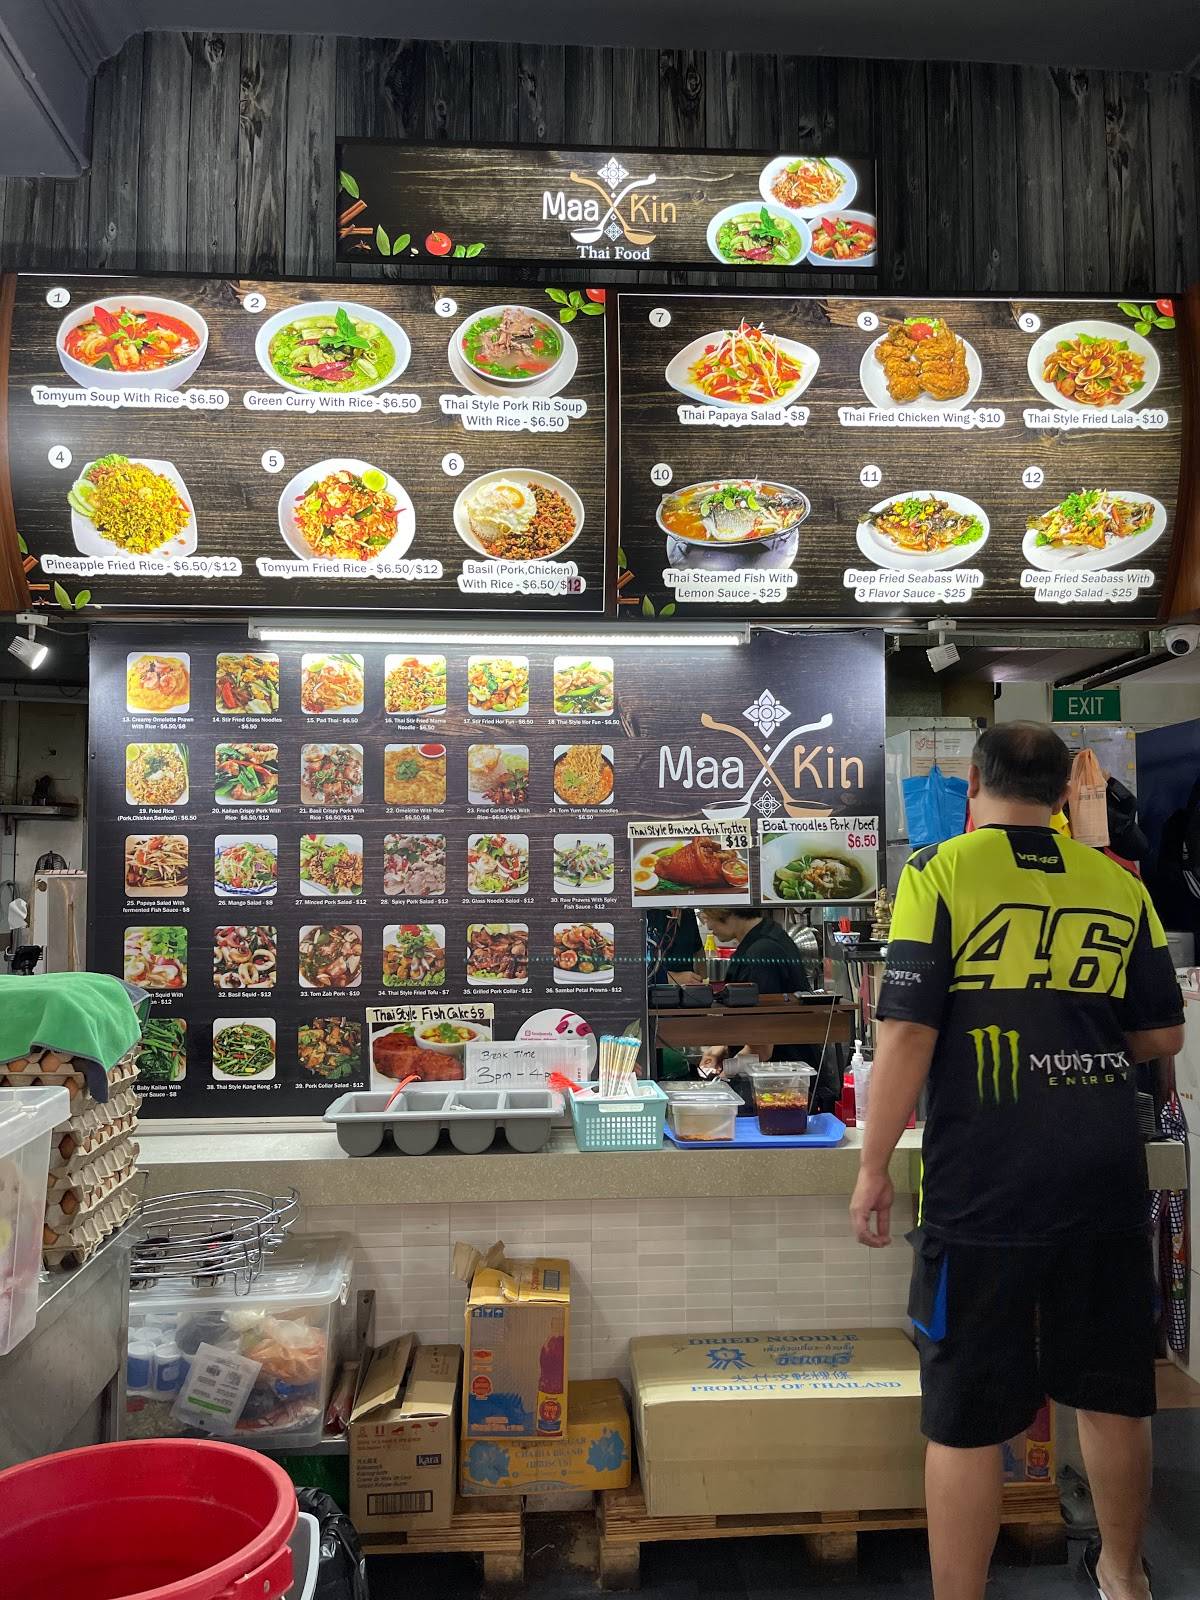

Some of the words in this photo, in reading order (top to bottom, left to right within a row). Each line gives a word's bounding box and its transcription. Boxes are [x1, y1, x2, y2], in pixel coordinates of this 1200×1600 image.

[542, 191, 599, 221] Maa
[631, 193, 676, 223] Kin
[576, 245, 610, 259] Thai
[614, 247, 650, 260] Food
[54, 293, 62, 302] 1
[251, 298, 259, 308] 2
[442, 302, 450, 312] 3
[656, 313, 664, 322] 7
[864, 317, 872, 326] 8
[1026, 318, 1034, 327] 9
[36, 390, 86, 403] Tomyum
[90, 391, 119, 403] Soup
[123, 392, 149, 402] With
[154, 393, 179, 403] Rice
[189, 394, 223, 404] $6.50
[248, 395, 282, 405] Green
[286, 396, 315, 408] Curry
[319, 397, 344, 406] With
[349, 397, 372, 407] Rice
[383, 398, 416, 408] $6.50
[444, 399, 468, 409] Thai
[471, 399, 499, 412] Style
[503, 400, 528, 410] Pork
[532, 401, 550, 410] Rib
[553, 401, 582, 413] Soup
[466, 415, 492, 425] With
[496, 416, 520, 426] Rice
[530, 416, 564, 427] $6.50
[681, 409, 704, 419] Thai
[708, 410, 747, 422] Papaya
[750, 410, 780, 420] Salad
[790, 411, 804, 420] $8
[842, 412, 864, 421] Thai
[869, 412, 894, 421] Fried
[897, 412, 939, 422] Chicken
[943, 413, 970, 424] Wing
[979, 412, 1000, 423] $10
[1027, 413, 1049, 423] Thai
[1053, 413, 1079, 425] Style
[1082, 414, 1107, 423] Fried
[1111, 414, 1133, 423] Lala
[1142, 414, 1163, 424] $10
[56, 452, 64, 462] 4
[269, 456, 277, 466] 5
[449, 458, 457, 470] 6
[654, 470, 669, 480] 10
[864, 471, 878, 482] 11
[1026, 472, 1040, 482] 12
[46, 559, 103, 571] Pineapple
[107, 560, 135, 570] Fried
[139, 560, 163, 570] Rice
[173, 560, 236, 572] $6.50/$12
[261, 562, 308, 574] Tomyum
[312, 563, 339, 572] Fried
[343, 563, 366, 572] Rice
[376, 563, 437, 575] $6.50/$12
[467, 564, 492, 573] Basil
[496, 564, 573, 576] (Pork,Chicken)
[667, 573, 689, 583] Thai
[692, 573, 740, 583] Steamed
[744, 573, 764, 582] Fish
[769, 573, 792, 582] With
[848, 573, 875, 584] Deep
[879, 573, 904, 583] Fried
[907, 573, 951, 583] Seabass
[955, 573, 978, 583] With
[1025, 574, 1050, 584] Deep
[1054, 573, 1078, 582] Fried
[1081, 574, 1123, 583] Seabass
[1127, 573, 1151, 586] With
[462, 579, 486, 588] With
[490, 578, 514, 587] Rice
[523, 577, 582, 592] $6.50/$12
[678, 588, 714, 598] Lemon
[717, 587, 750, 596] Sauce
[759, 587, 781, 597] $25
[858, 588, 865, 597] 3
[868, 588, 900, 597] Flavor
[902, 588, 935, 598] Sauce
[943, 588, 965, 598] $25
[1038, 587, 1071, 598] Mango
[1074, 586, 1103, 596] Salad
[1112, 587, 1133, 597] $25
[1068, 697, 1104, 715] EXIT
[658, 745, 744, 788] Maa
[794, 745, 864, 789] Kin
[668, 823, 700, 835] Braised
[701, 823, 720, 835] Pork
[719, 821, 747, 835] Trotter
[762, 819, 788, 831] Boat
[789, 819, 828, 831] noodles
[829, 818, 849, 831] Pork
[726, 835, 748, 848] $18
[847, 833, 877, 848] $6.50
[949, 903, 1136, 998] 46
[373, 1009, 395, 1021] Thai
[396, 1007, 417, 1021] Style
[422, 1006, 445, 1020] Fish
[447, 1007, 469, 1019] Cake
[470, 1006, 485, 1019] $8
[1030, 1050, 1130, 1076] MONSTER
[477, 1066, 512, 1084] 3pm
[529, 1068, 551, 1081] 4p
[1049, 1072, 1128, 1086] ENERGY
[688, 1336, 759, 1345] DRIED
[767, 1334, 860, 1343] NOODLE
[690, 1384, 775, 1393] PRODUCT
[781, 1383, 805, 1391] OF
[807, 1381, 902, 1390] THAILAND
[419, 1455, 439, 1465] kara
